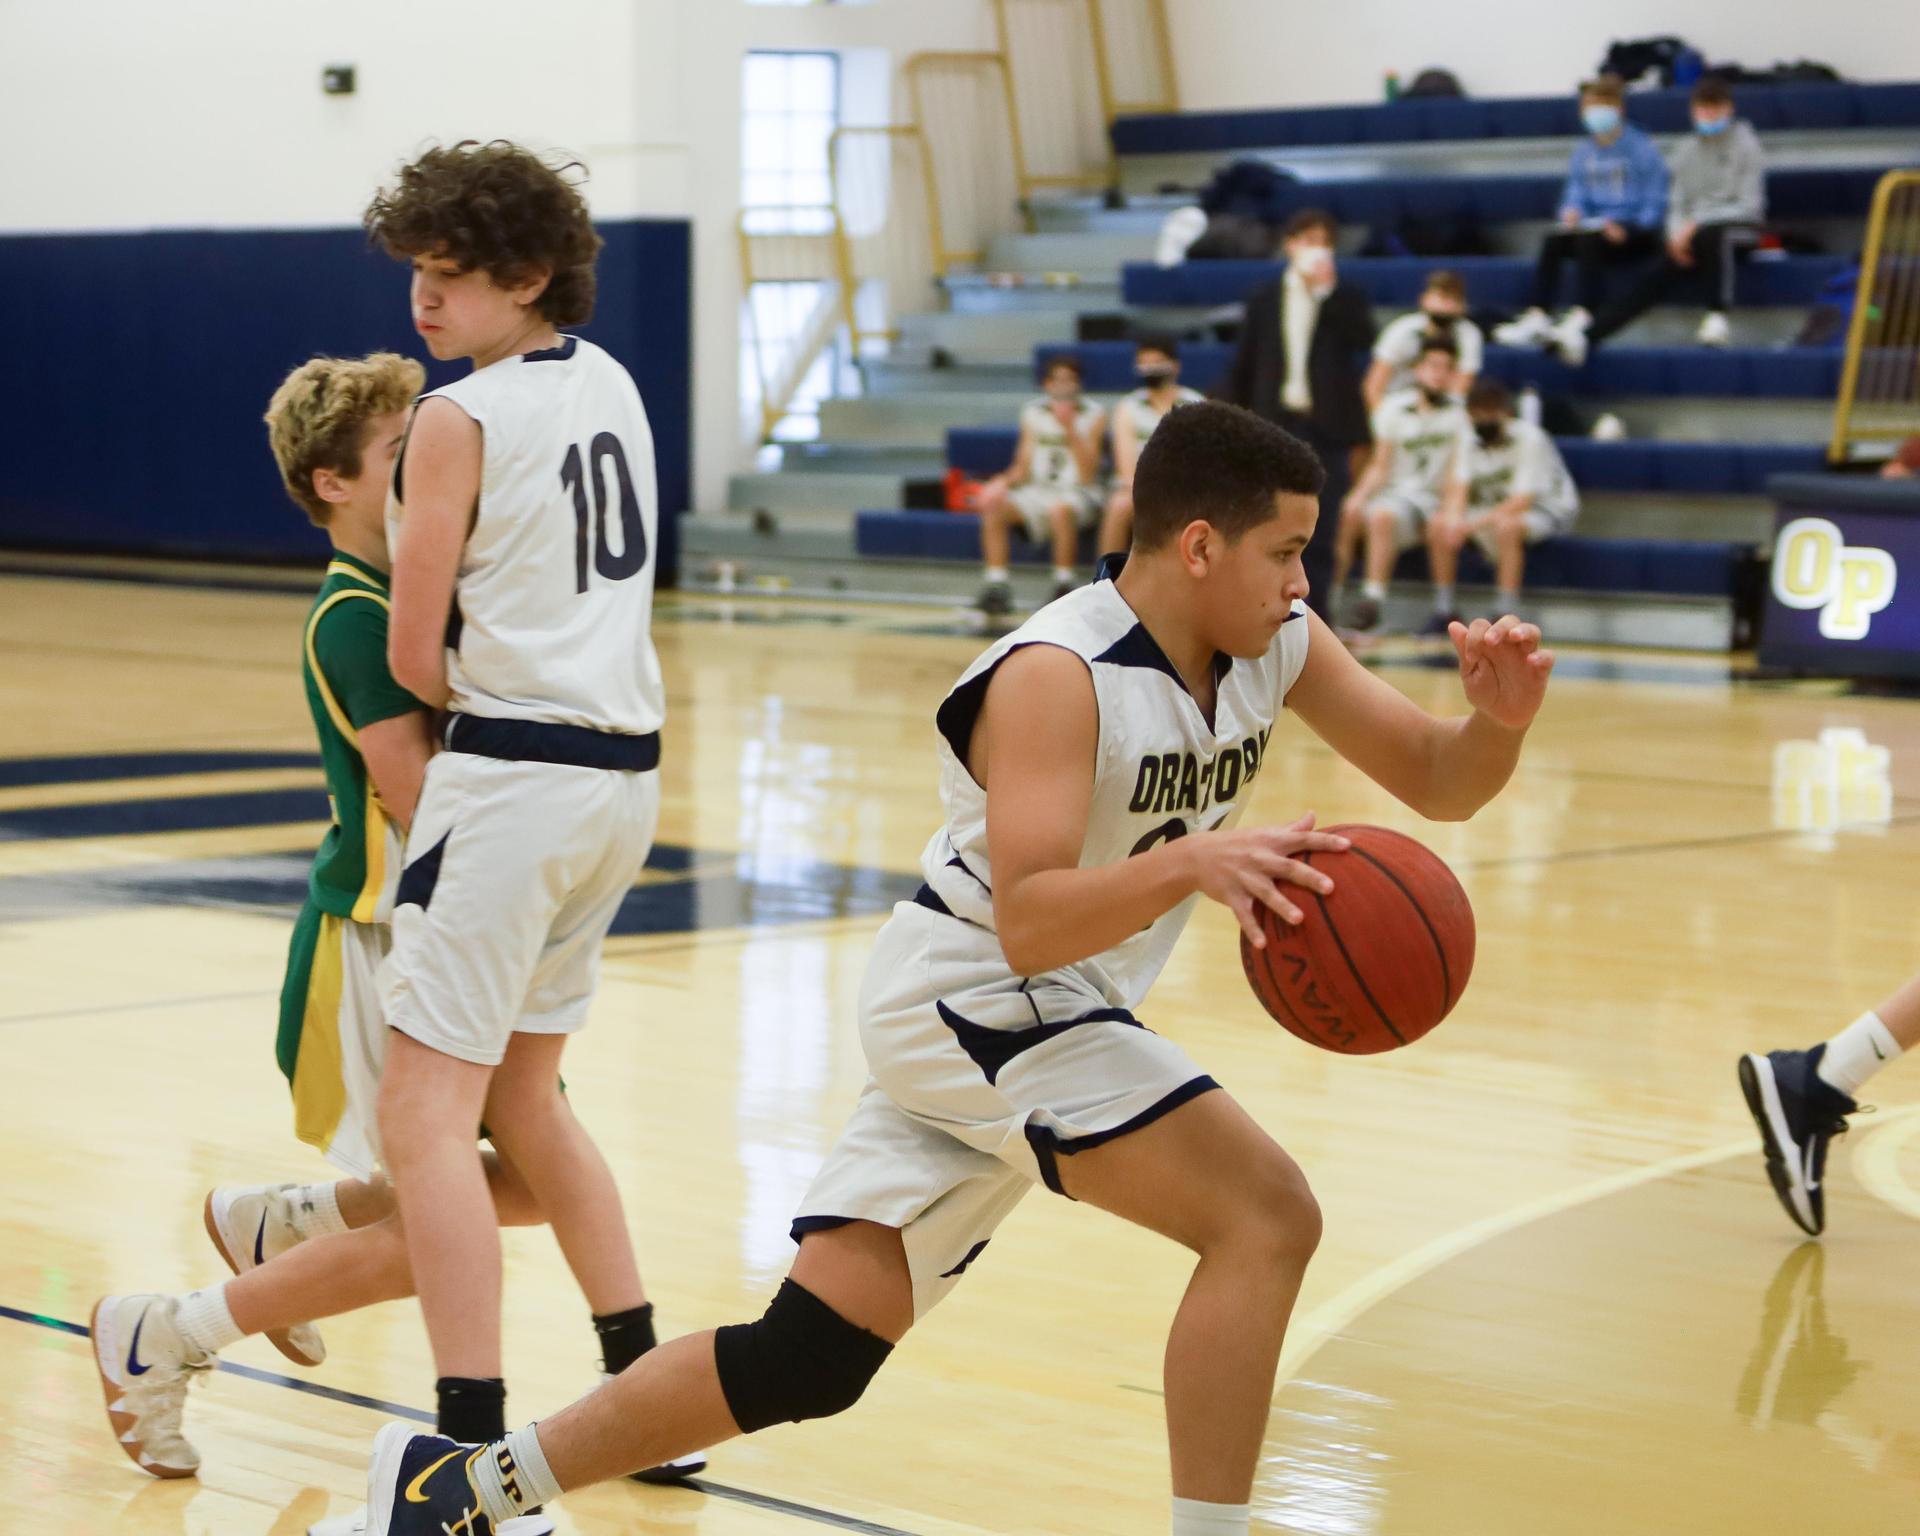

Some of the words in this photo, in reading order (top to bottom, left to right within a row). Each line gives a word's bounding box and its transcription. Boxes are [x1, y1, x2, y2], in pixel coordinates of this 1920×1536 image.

[560, 431, 647, 594] 10
[1773, 518, 1896, 640] OP
[496, 1446, 523, 1503] OP
